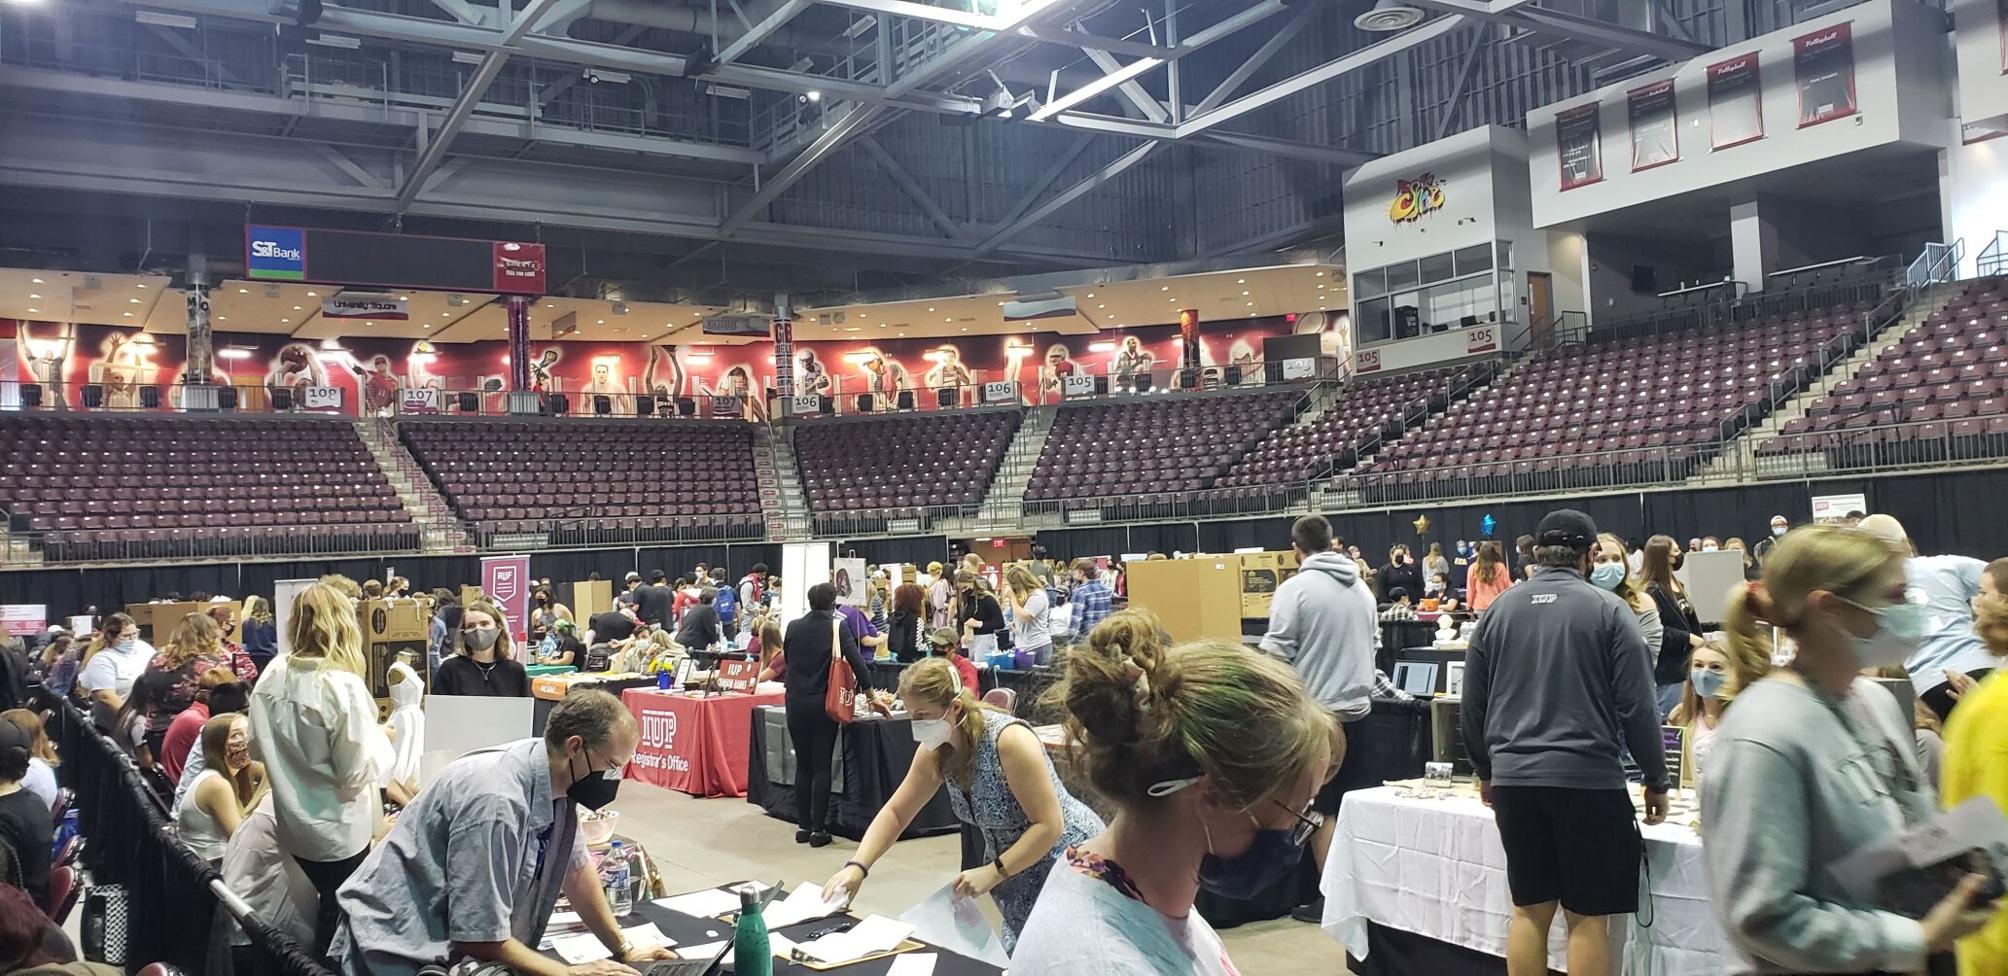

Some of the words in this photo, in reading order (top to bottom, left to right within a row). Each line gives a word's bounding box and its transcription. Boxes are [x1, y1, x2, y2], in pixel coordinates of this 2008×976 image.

[252, 240, 277, 257] S&T
[273, 248, 300, 258] Bank
[334, 301, 369, 310] University
[1470, 330, 1493, 343] 105
[1358, 352, 1378, 363] 105
[1068, 376, 1091, 387] 105
[309, 388, 336, 399] 108
[988, 383, 1011, 393] 106
[407, 390, 433, 405] 107
[716, 397, 736, 408] 107
[795, 397, 817, 408] 106
[497, 572, 513, 581] RUF
[1531, 594, 1558, 604] IUP
[727, 663, 743, 676] IUP
[642, 710, 676, 749] IUP
[667, 755, 689, 772] Office
